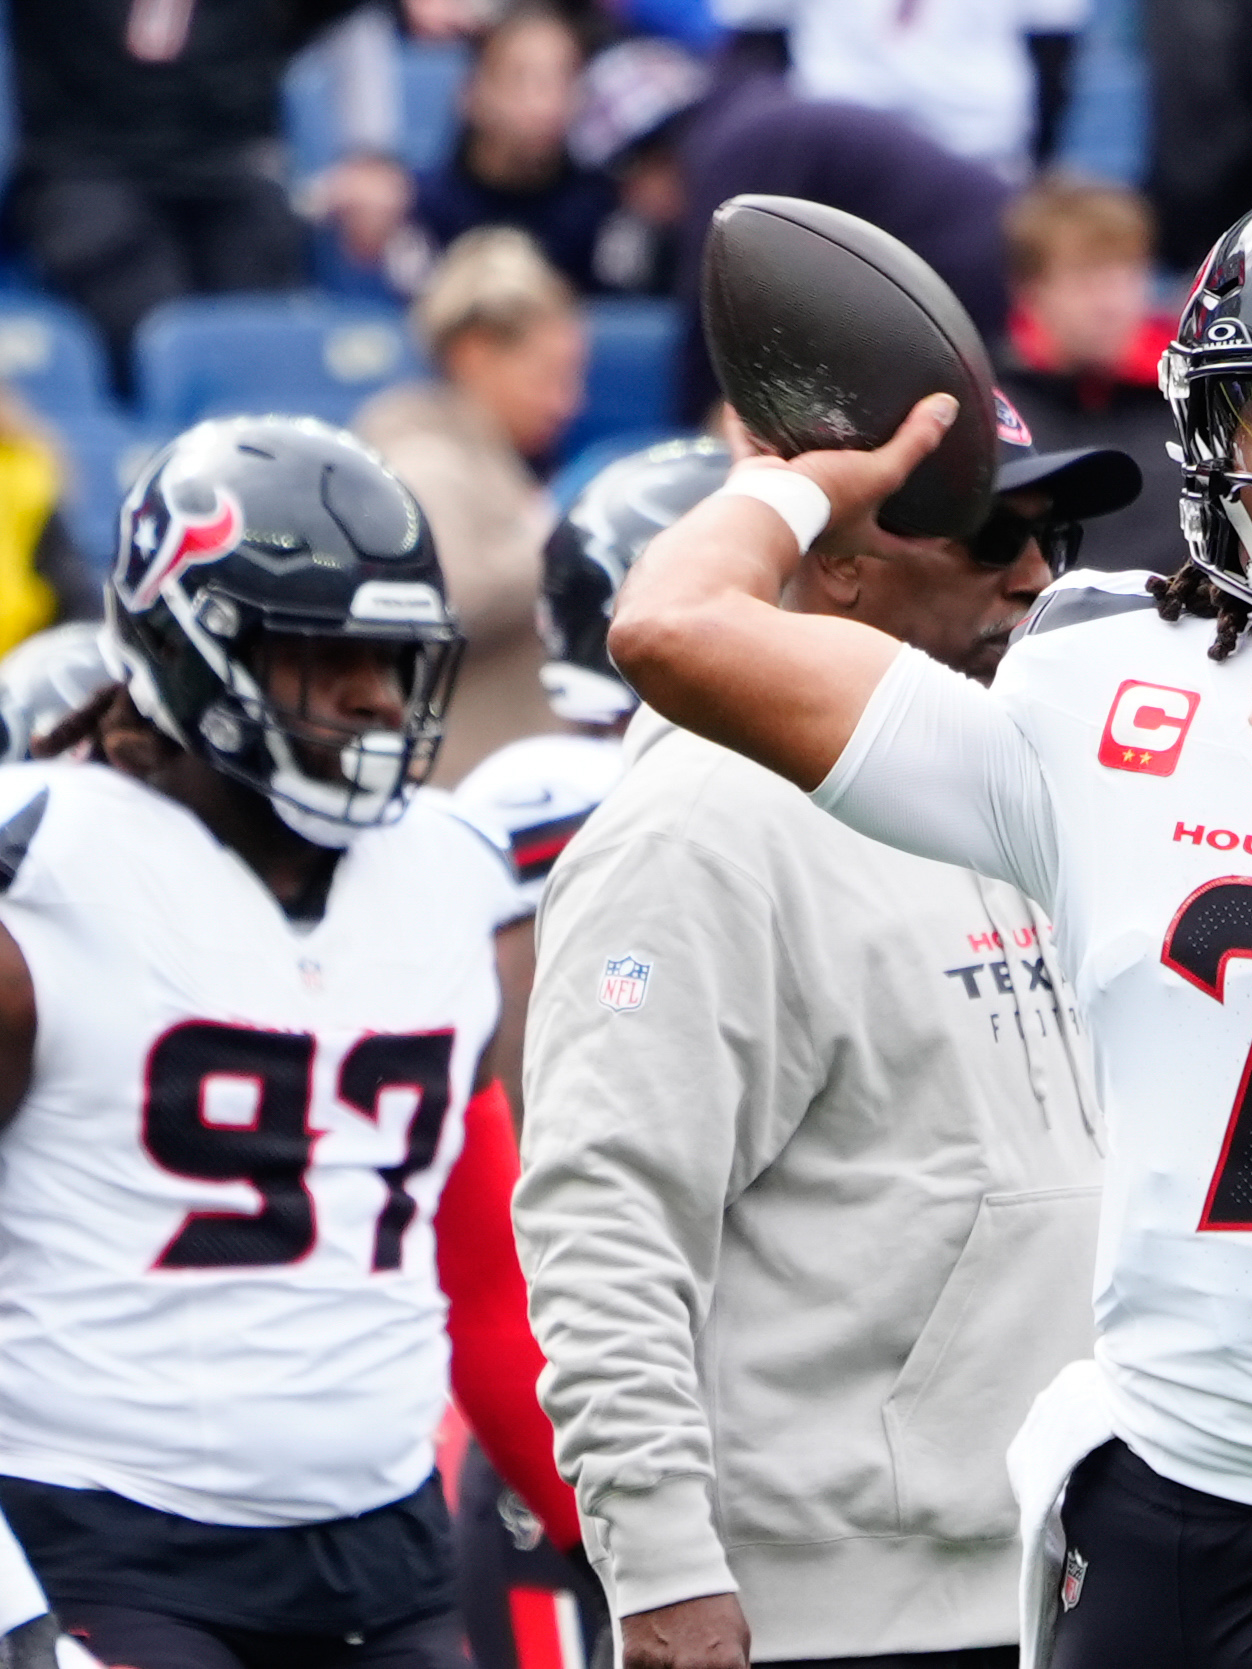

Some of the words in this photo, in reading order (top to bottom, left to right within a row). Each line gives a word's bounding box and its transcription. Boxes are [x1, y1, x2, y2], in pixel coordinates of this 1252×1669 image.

[1110, 685, 1190, 752] C
[602, 979, 639, 1006] NFL
[141, 1018, 455, 1275] 97
